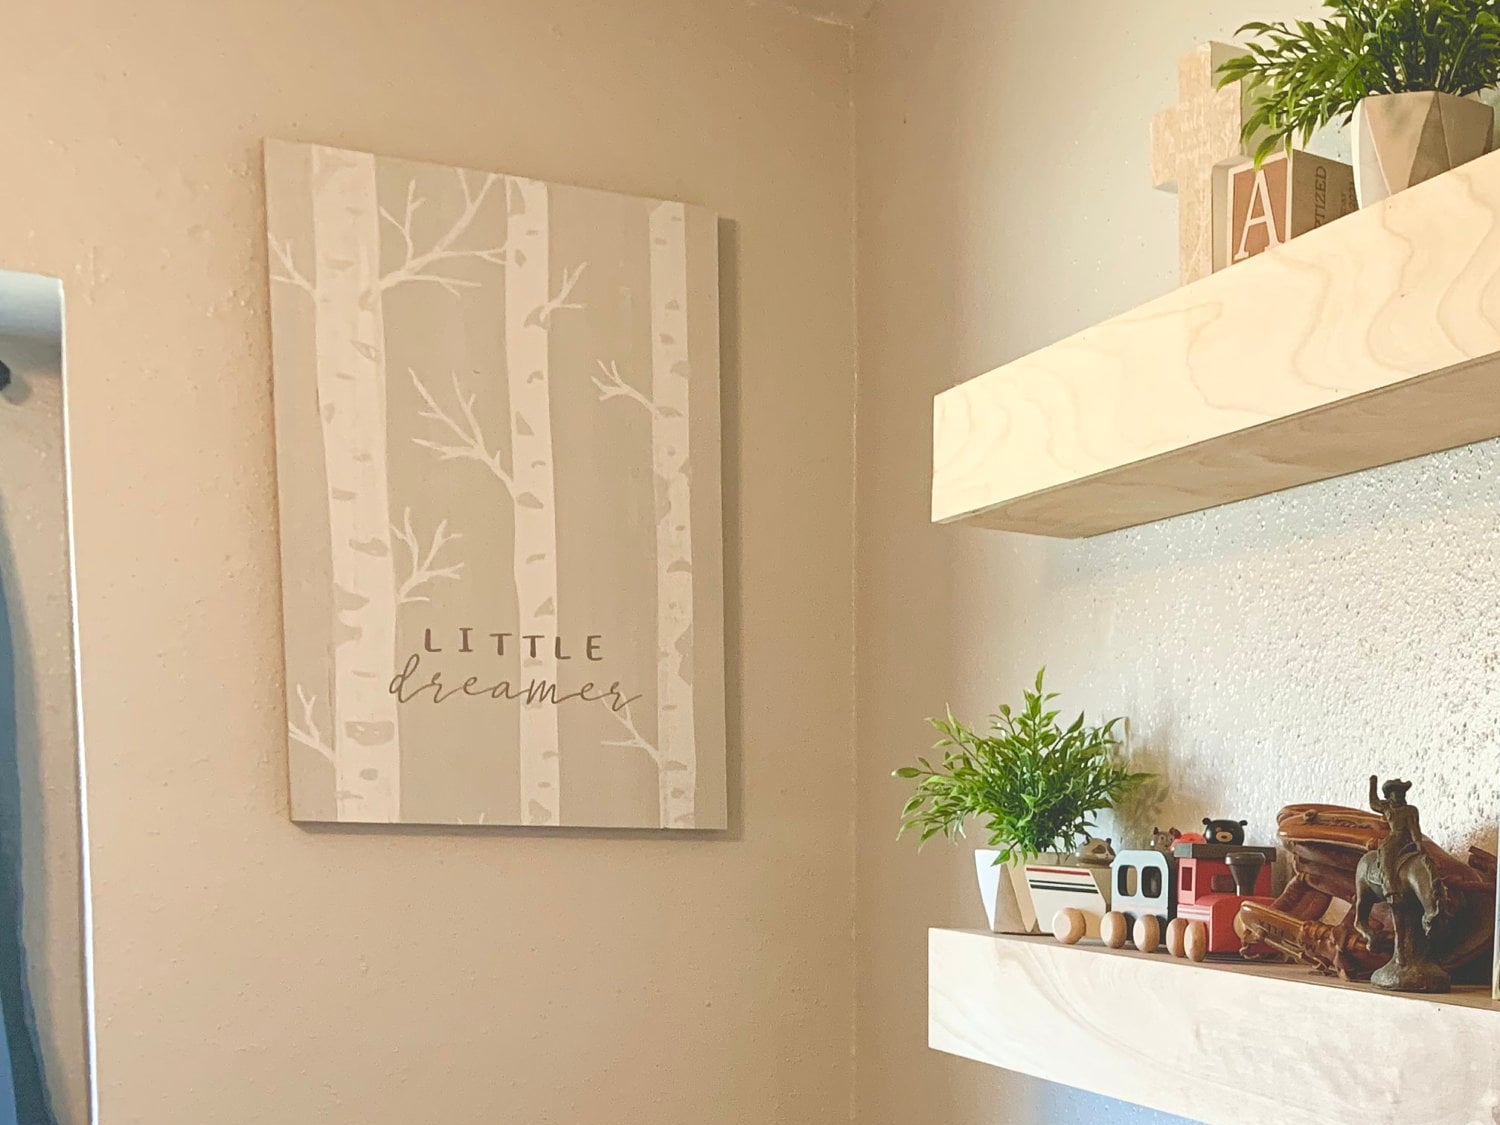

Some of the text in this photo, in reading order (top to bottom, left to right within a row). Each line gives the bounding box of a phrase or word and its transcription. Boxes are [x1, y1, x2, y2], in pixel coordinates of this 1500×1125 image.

[1234, 169, 1285, 260] A
[423, 627, 604, 661] LITTLE
[388, 653, 644, 712] dreamer
